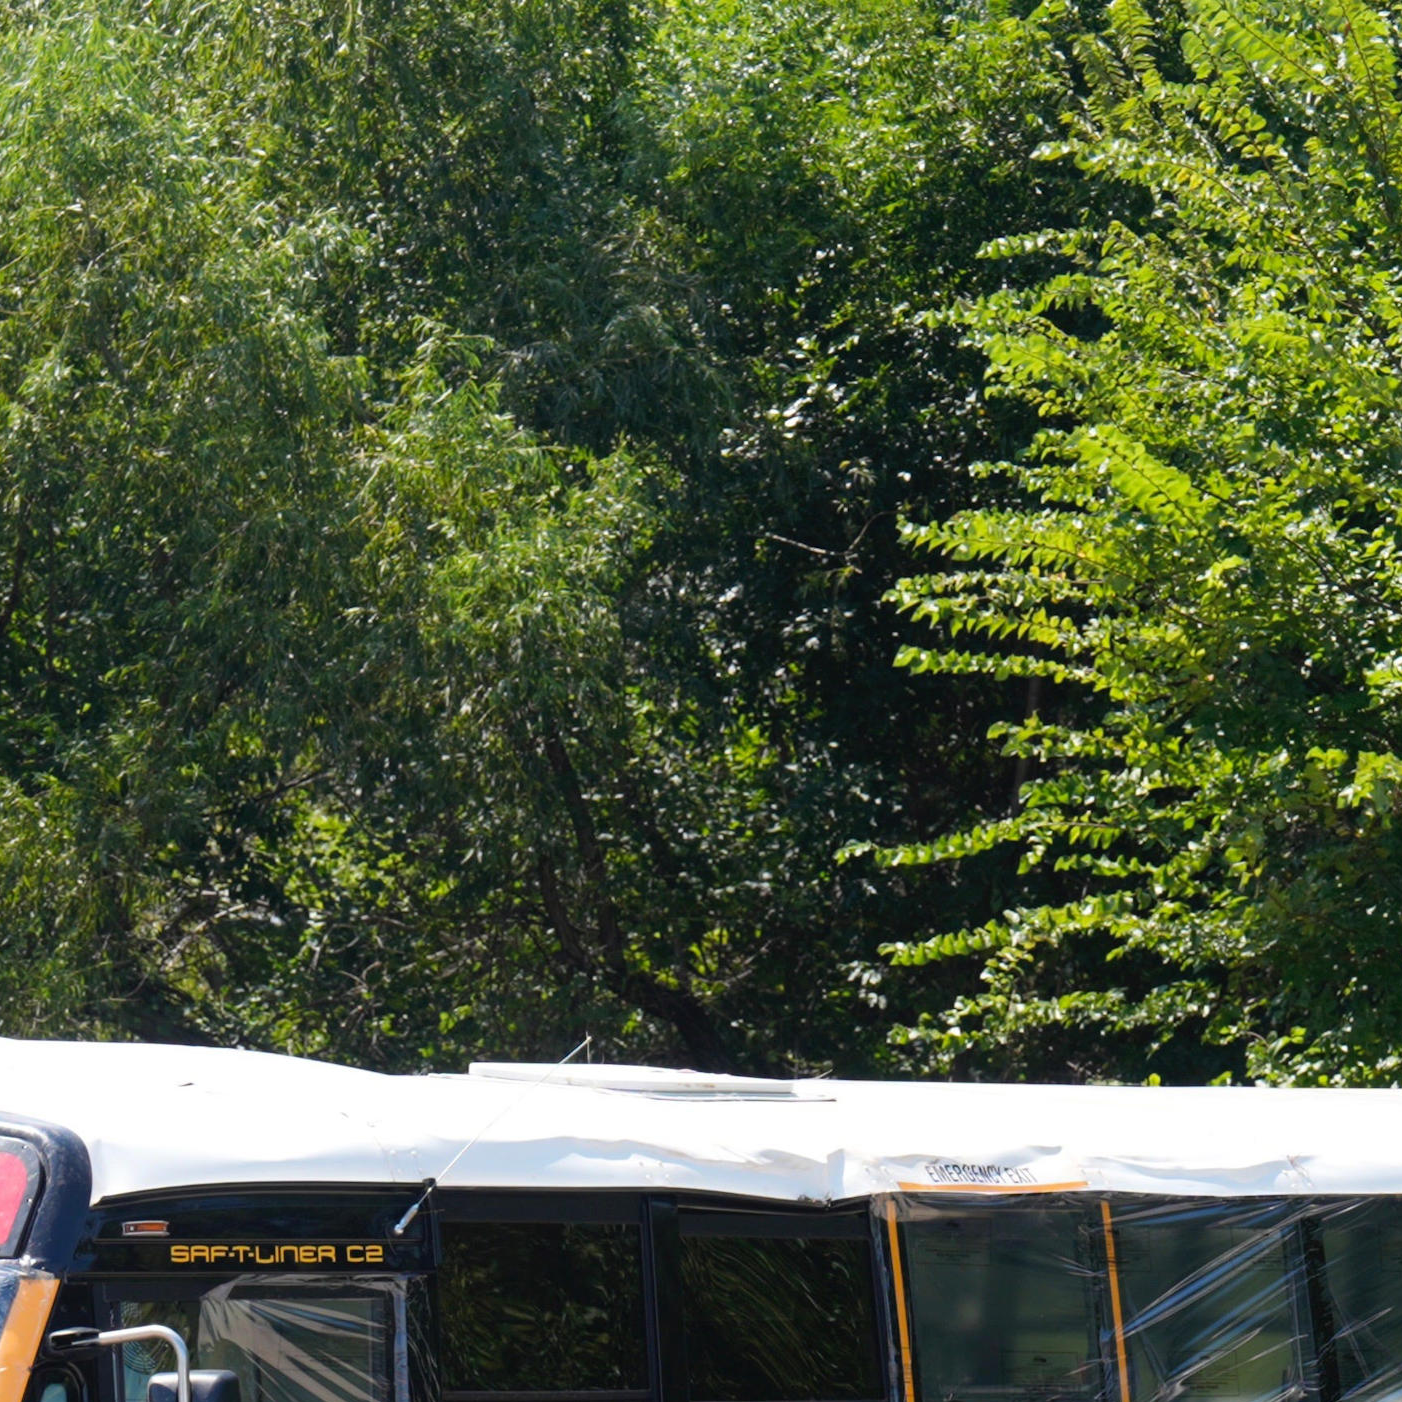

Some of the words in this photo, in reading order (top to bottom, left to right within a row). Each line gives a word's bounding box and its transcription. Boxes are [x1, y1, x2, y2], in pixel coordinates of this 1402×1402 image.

[925, 1164, 1006, 1184] EMERGENCY
[1004, 1167, 1038, 1184] EXIT
[170, 1244, 336, 1264] SAF-T-LINER
[346, 1244, 384, 1263] C2
